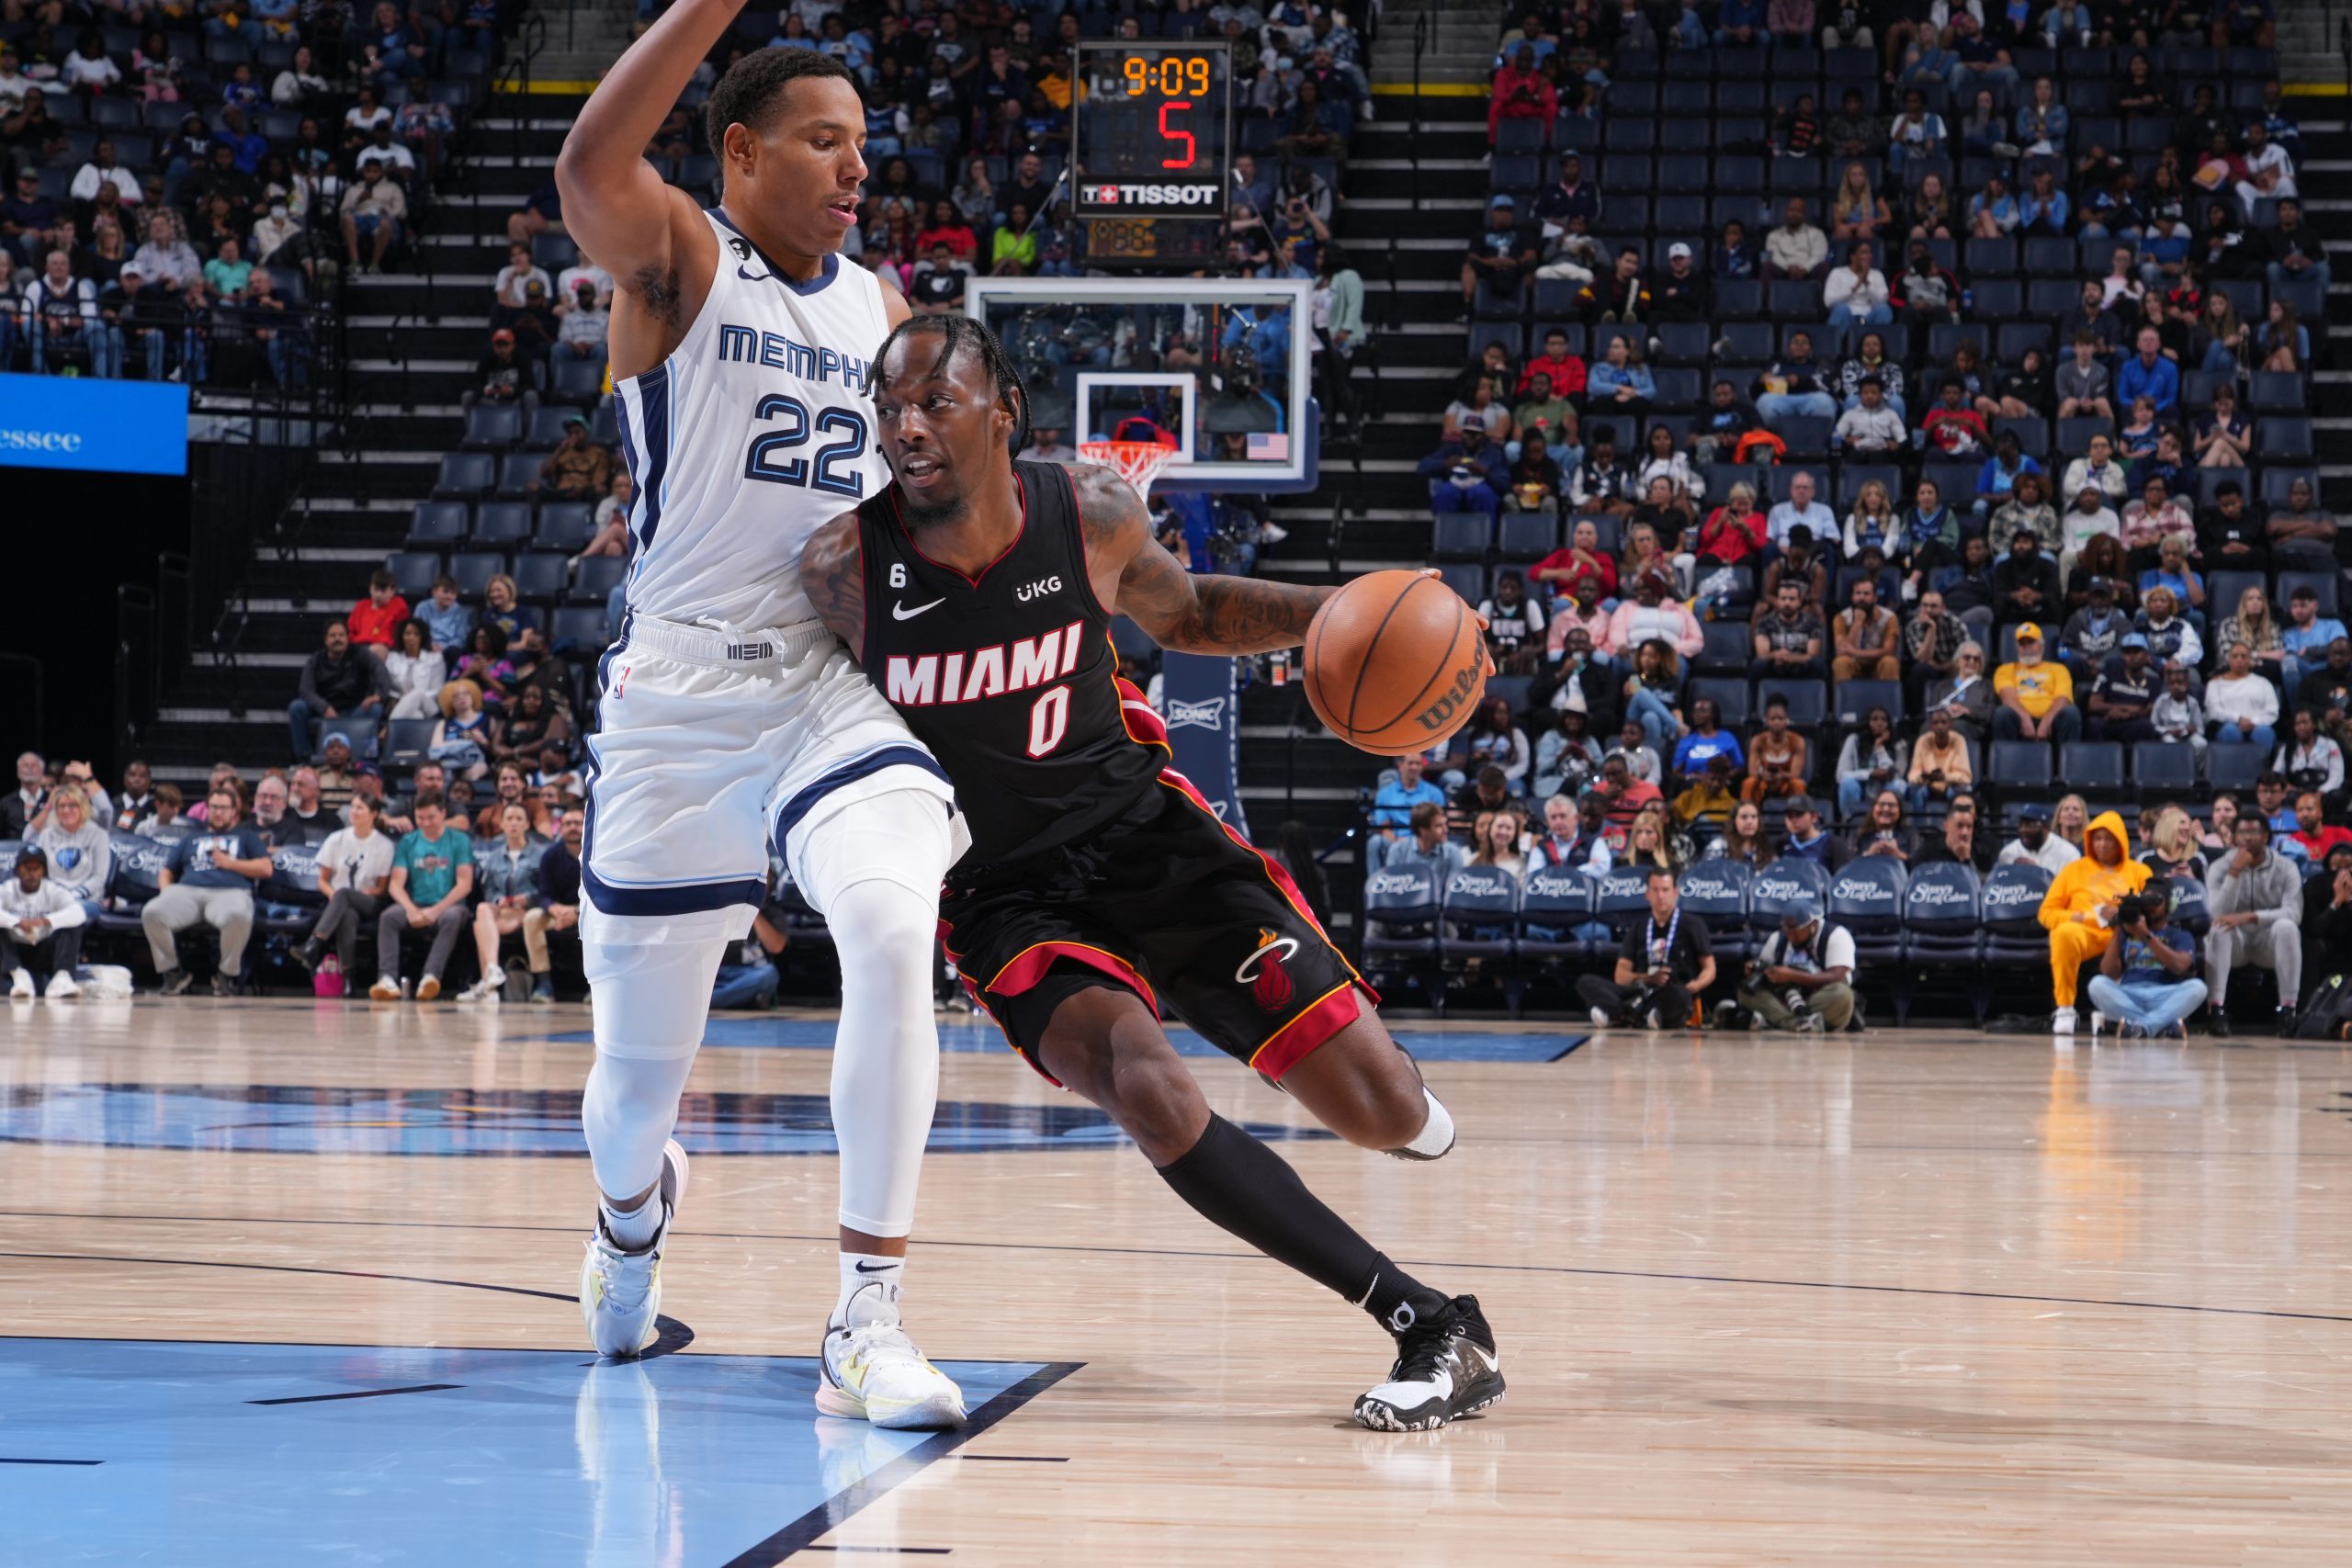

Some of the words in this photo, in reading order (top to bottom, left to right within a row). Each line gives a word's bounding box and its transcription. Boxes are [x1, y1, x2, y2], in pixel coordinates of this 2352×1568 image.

[1124, 57, 1209, 96] 9:09
[1159, 101, 1195, 168] 5
[1119, 186, 1218, 204] TISSOT
[718, 324, 872, 395] MEMPHI
[744, 393, 867, 499] 22
[889, 563, 907, 588] 6
[886, 620, 1083, 707] MIAMI
[1026, 683, 1072, 760] 0
[1174, 707, 1215, 721] SONIC
